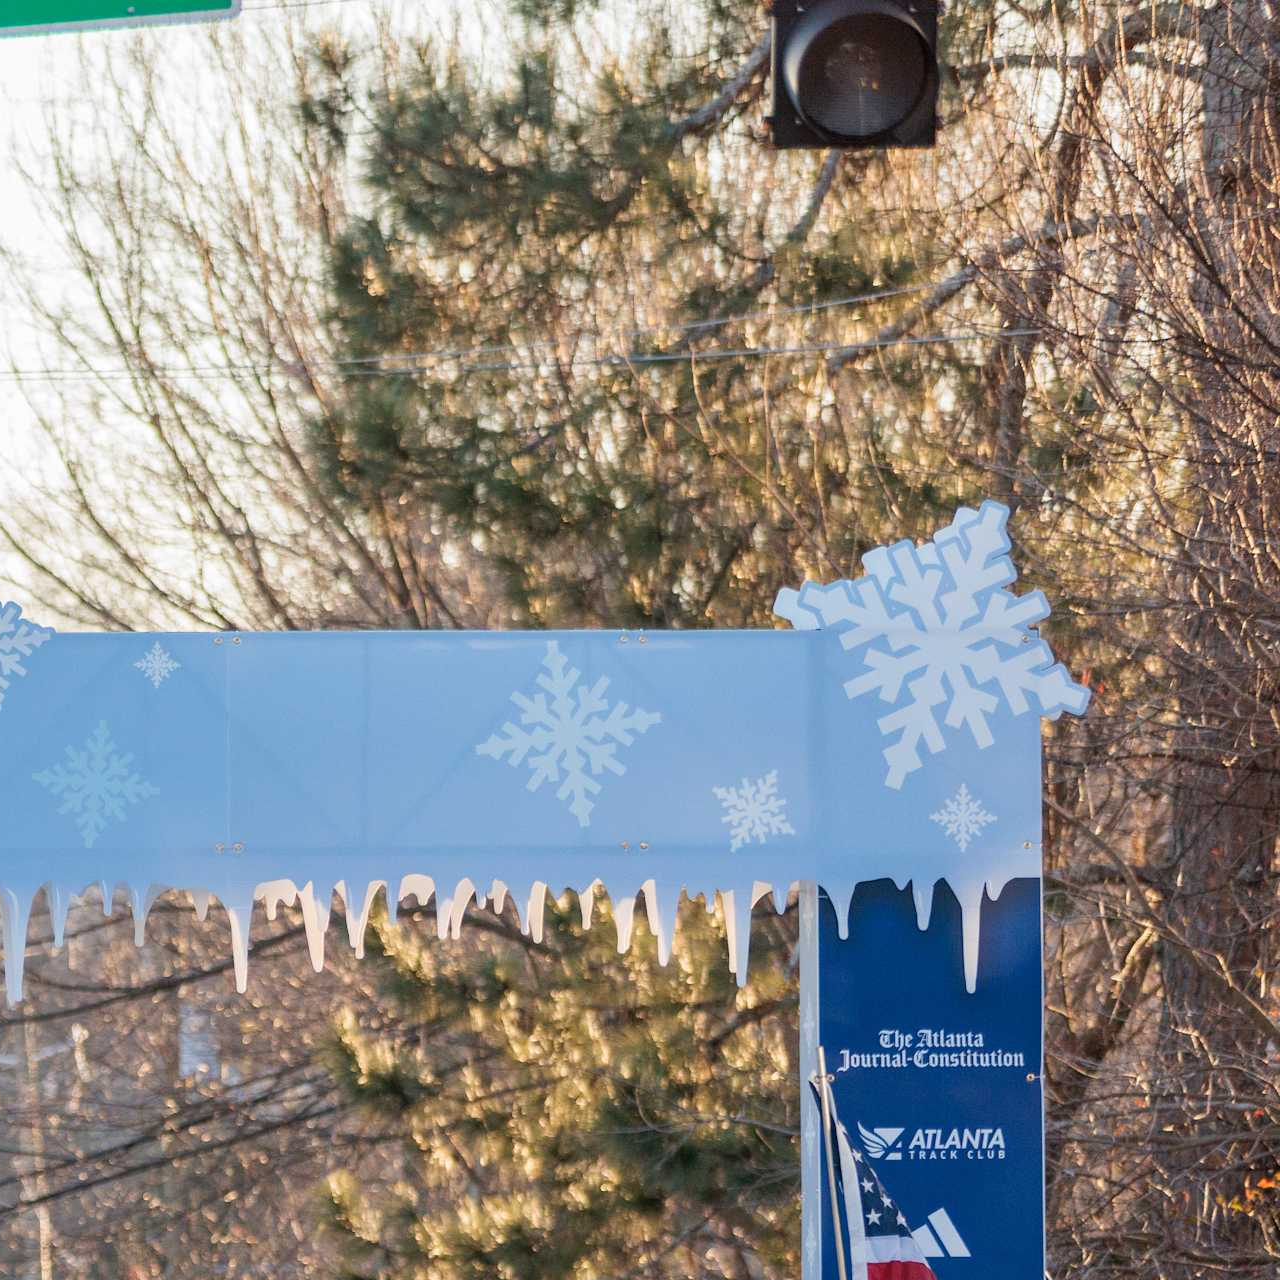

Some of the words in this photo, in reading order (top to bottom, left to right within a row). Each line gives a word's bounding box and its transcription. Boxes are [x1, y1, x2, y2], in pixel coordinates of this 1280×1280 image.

[878, 1030, 913, 1049] The
[916, 1028, 985, 1048] Atlanta
[837, 1049, 1025, 1073] Journal-Constitution
[908, 1127, 1006, 1150] ATLANTA
[908, 1150, 962, 1161] TRACK
[967, 1150, 1006, 1161] CLUB
